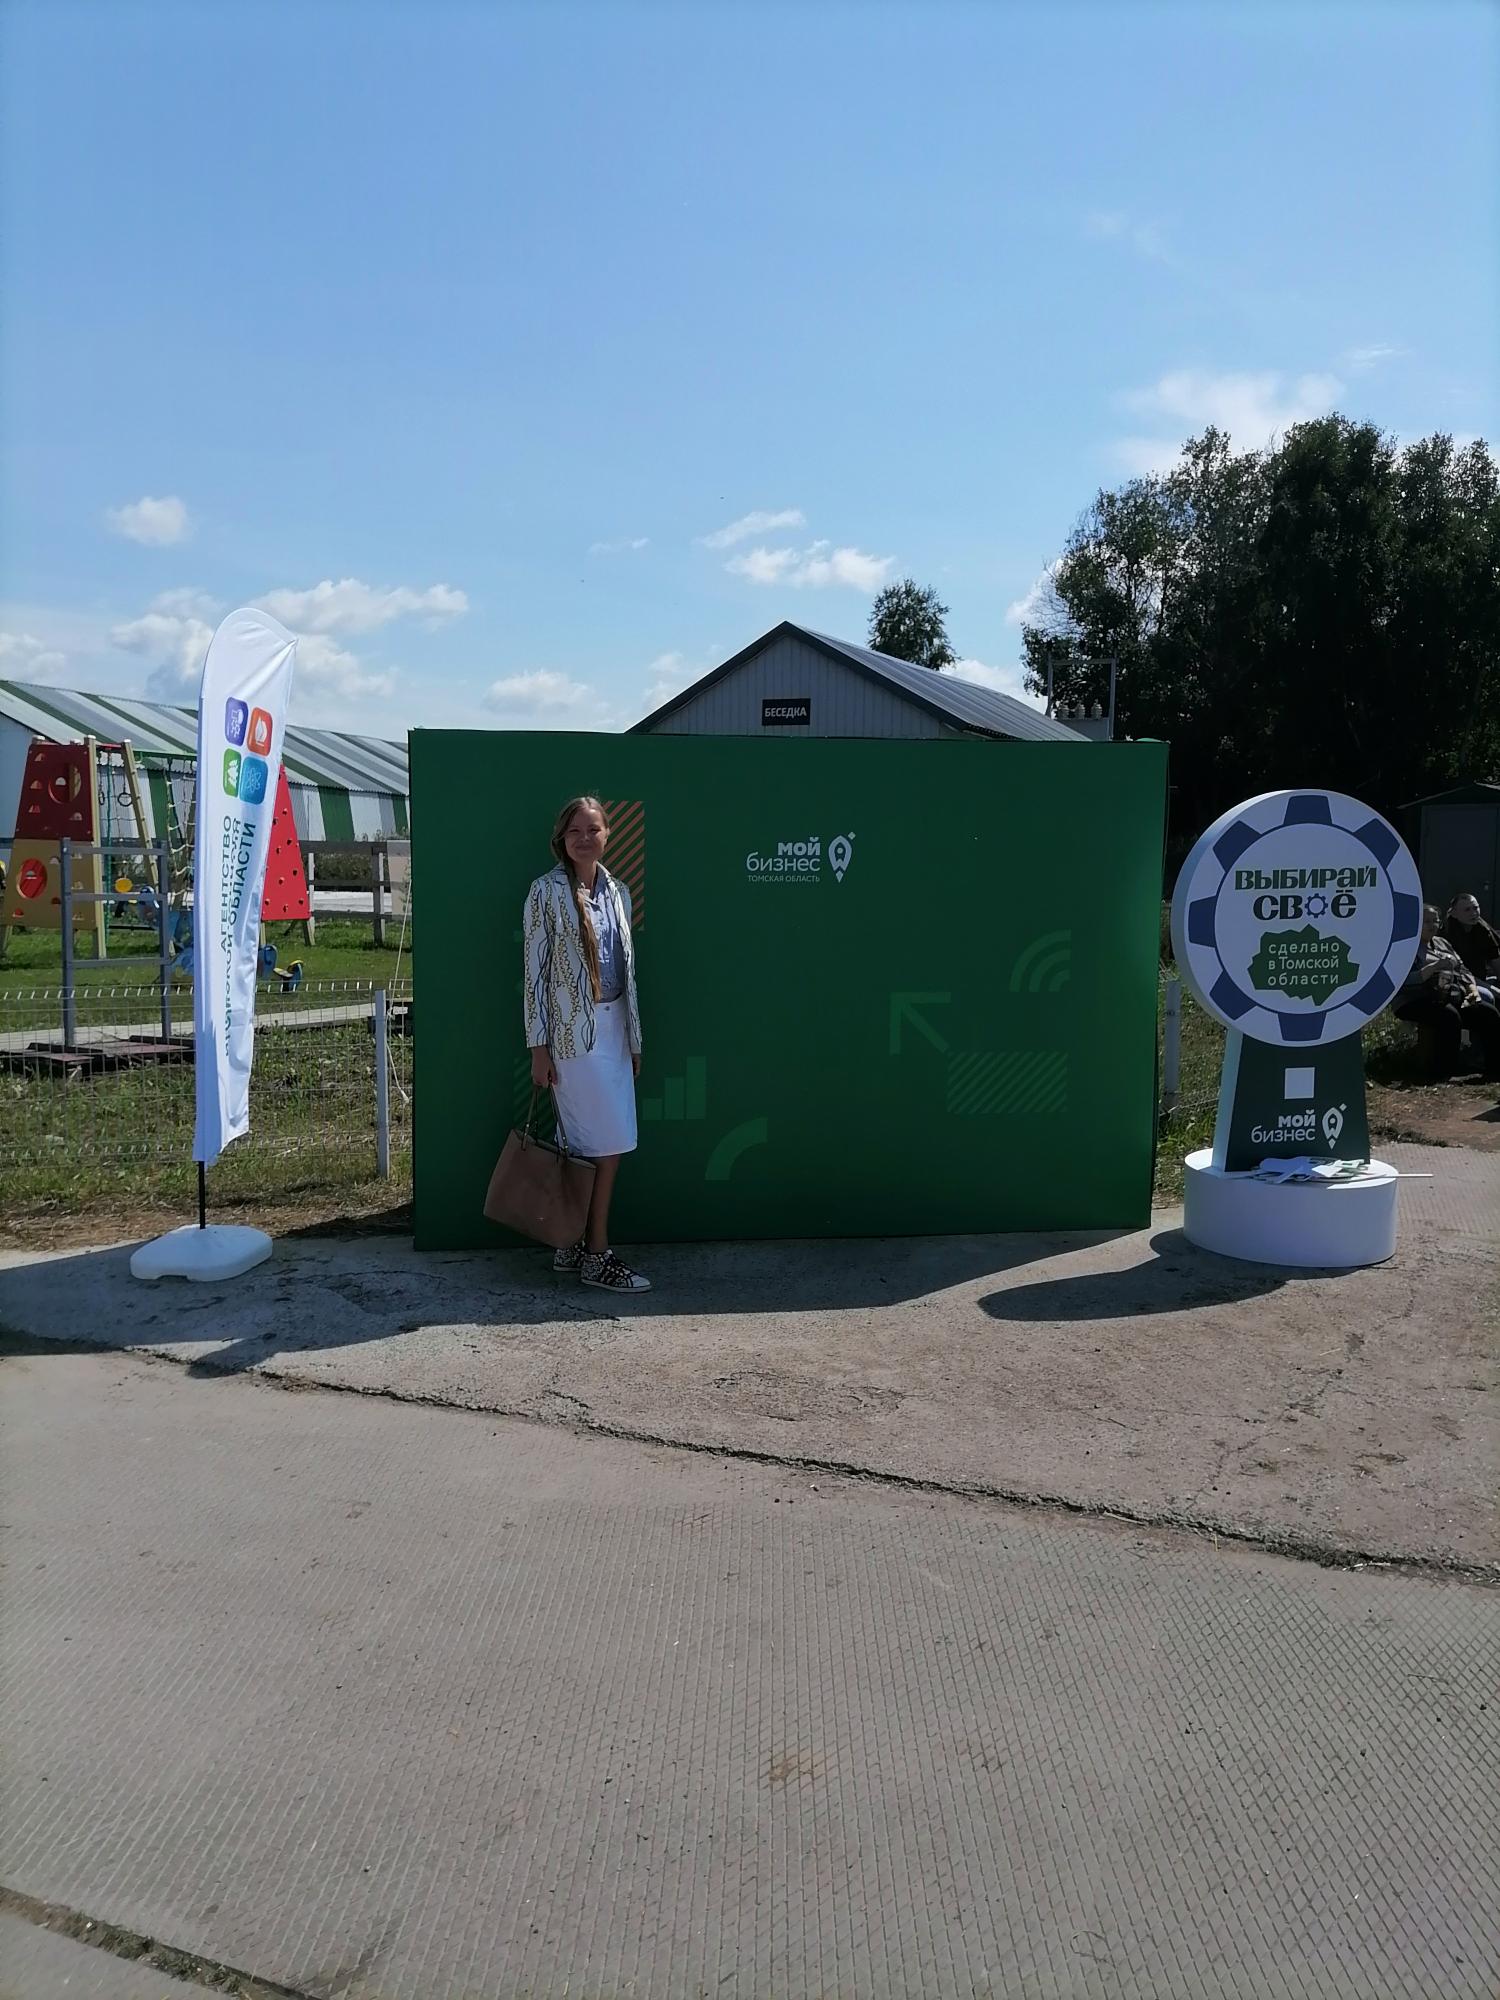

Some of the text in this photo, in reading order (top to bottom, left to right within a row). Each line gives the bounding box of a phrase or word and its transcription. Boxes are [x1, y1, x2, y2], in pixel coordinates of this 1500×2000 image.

[764, 706, 807, 719] БЕСЕДКА
[777, 837, 821, 856] мой
[746, 851, 821, 872] бизнес
[230, 822, 256, 926] ОБЛАСТИ
[748, 874, 821, 883] ТОМСКАЯ ОБЛАСТЬ
[220, 815, 231, 952] АГЕНТСТВО
[1268, 942, 1340, 956] сделано
[1268, 955, 1340, 970] в Томской
[1267, 973, 1339, 986] области
[1278, 1109, 1316, 1128] мой
[1251, 1125, 1316, 1143] бизнес
